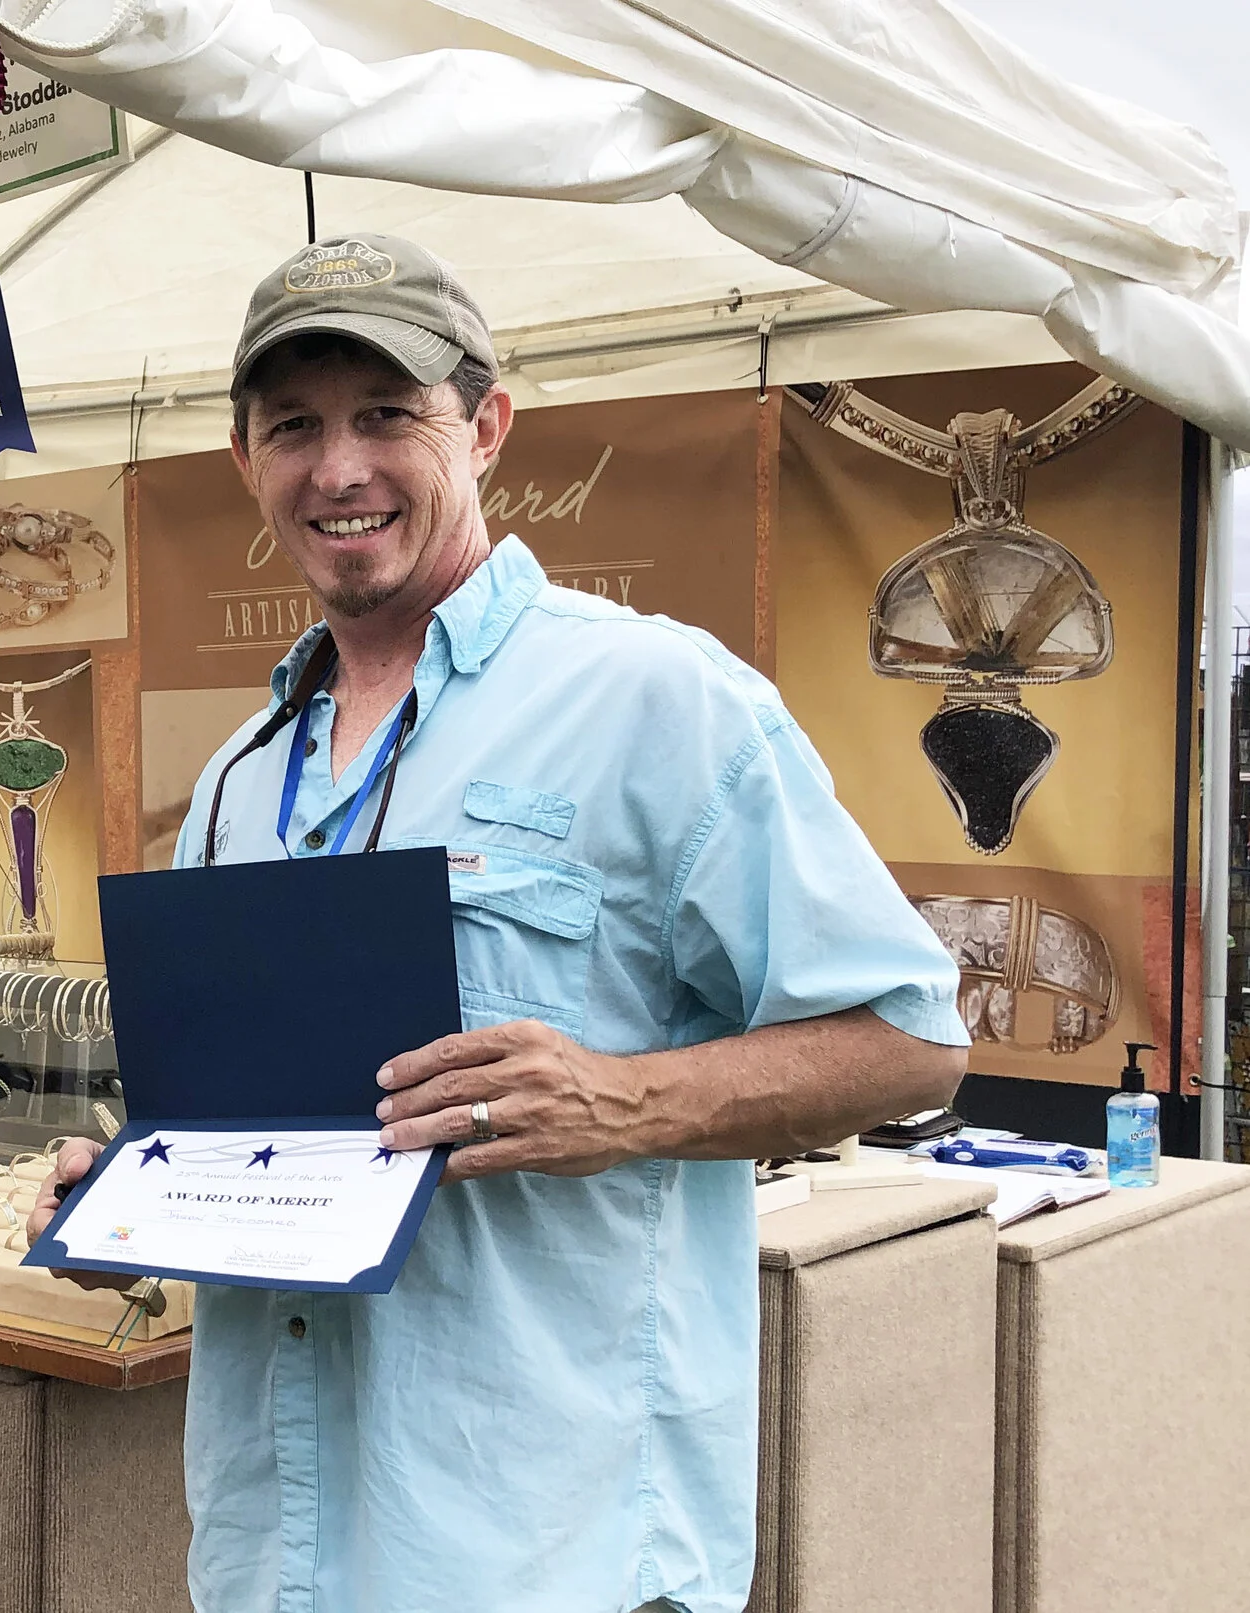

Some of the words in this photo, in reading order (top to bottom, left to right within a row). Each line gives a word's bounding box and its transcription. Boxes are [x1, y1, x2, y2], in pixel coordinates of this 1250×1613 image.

[8, 112, 56, 138] Alabama
[352, 244, 385, 264] KEY
[299, 268, 375, 288] FLORIDA
[224, 597, 325, 638] ARTISA
[242, 1172, 282, 1182] Festival
[284, 1173, 298, 1182] of
[299, 1173, 316, 1182] the
[318, 1174, 344, 1182] Arts
[160, 1191, 232, 1204] AWARD
[236, 1195, 265, 1205] OF
[265, 1196, 334, 1207] MERIT
